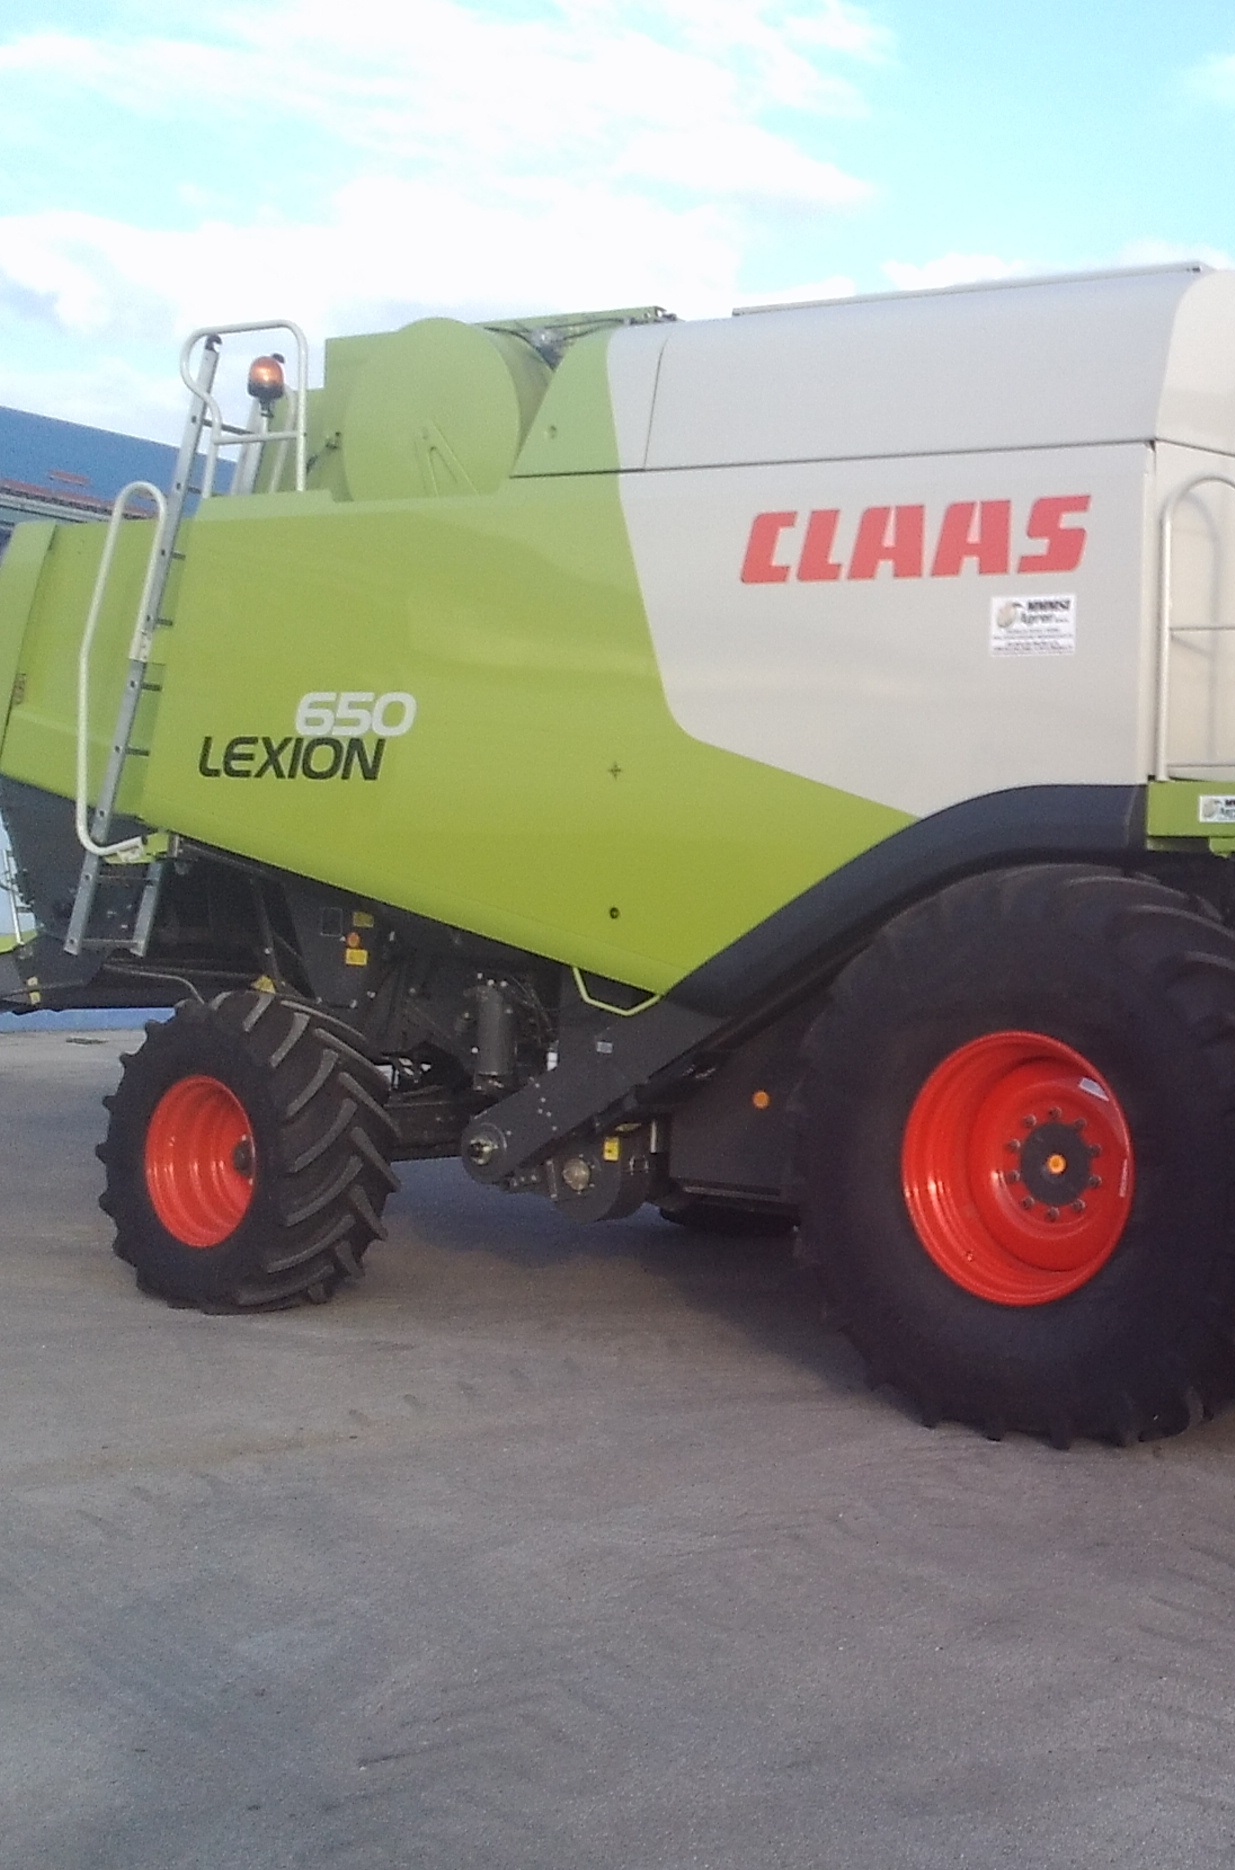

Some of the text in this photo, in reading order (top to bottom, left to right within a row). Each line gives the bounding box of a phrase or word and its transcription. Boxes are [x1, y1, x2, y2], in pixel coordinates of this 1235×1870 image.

[740, 494, 1092, 585] CLAAS
[294, 691, 418, 737] 650
[198, 735, 387, 781] LEXION
